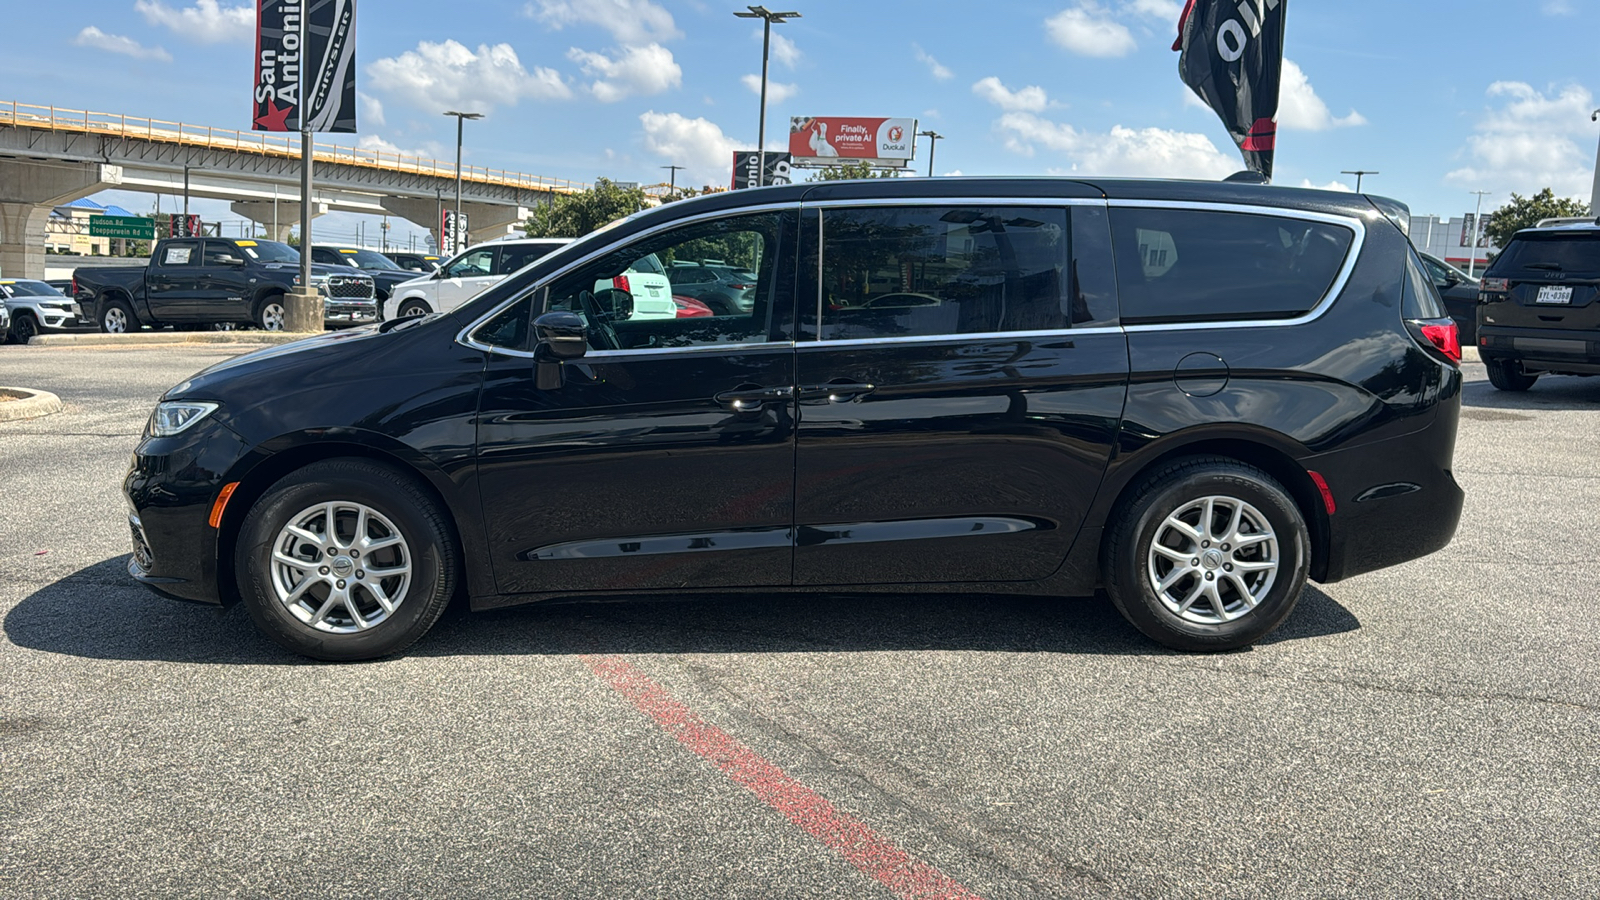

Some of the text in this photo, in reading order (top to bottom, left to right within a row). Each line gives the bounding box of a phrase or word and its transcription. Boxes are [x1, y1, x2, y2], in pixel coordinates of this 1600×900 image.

[277, 0, 300, 106] Antoni
[315, 10, 350, 111] CHRYSLER
[255, 49, 276, 104] San
[835, 133, 872, 143] private AI
[840, 124, 868, 134] Finally,
[882, 143, 905, 151] Duck.ai
[746, 155, 759, 188] onio
[92, 226, 131, 236] Toepperwein
[448, 213, 456, 257] Antonio
[1544, 271, 1566, 279] Jeep
